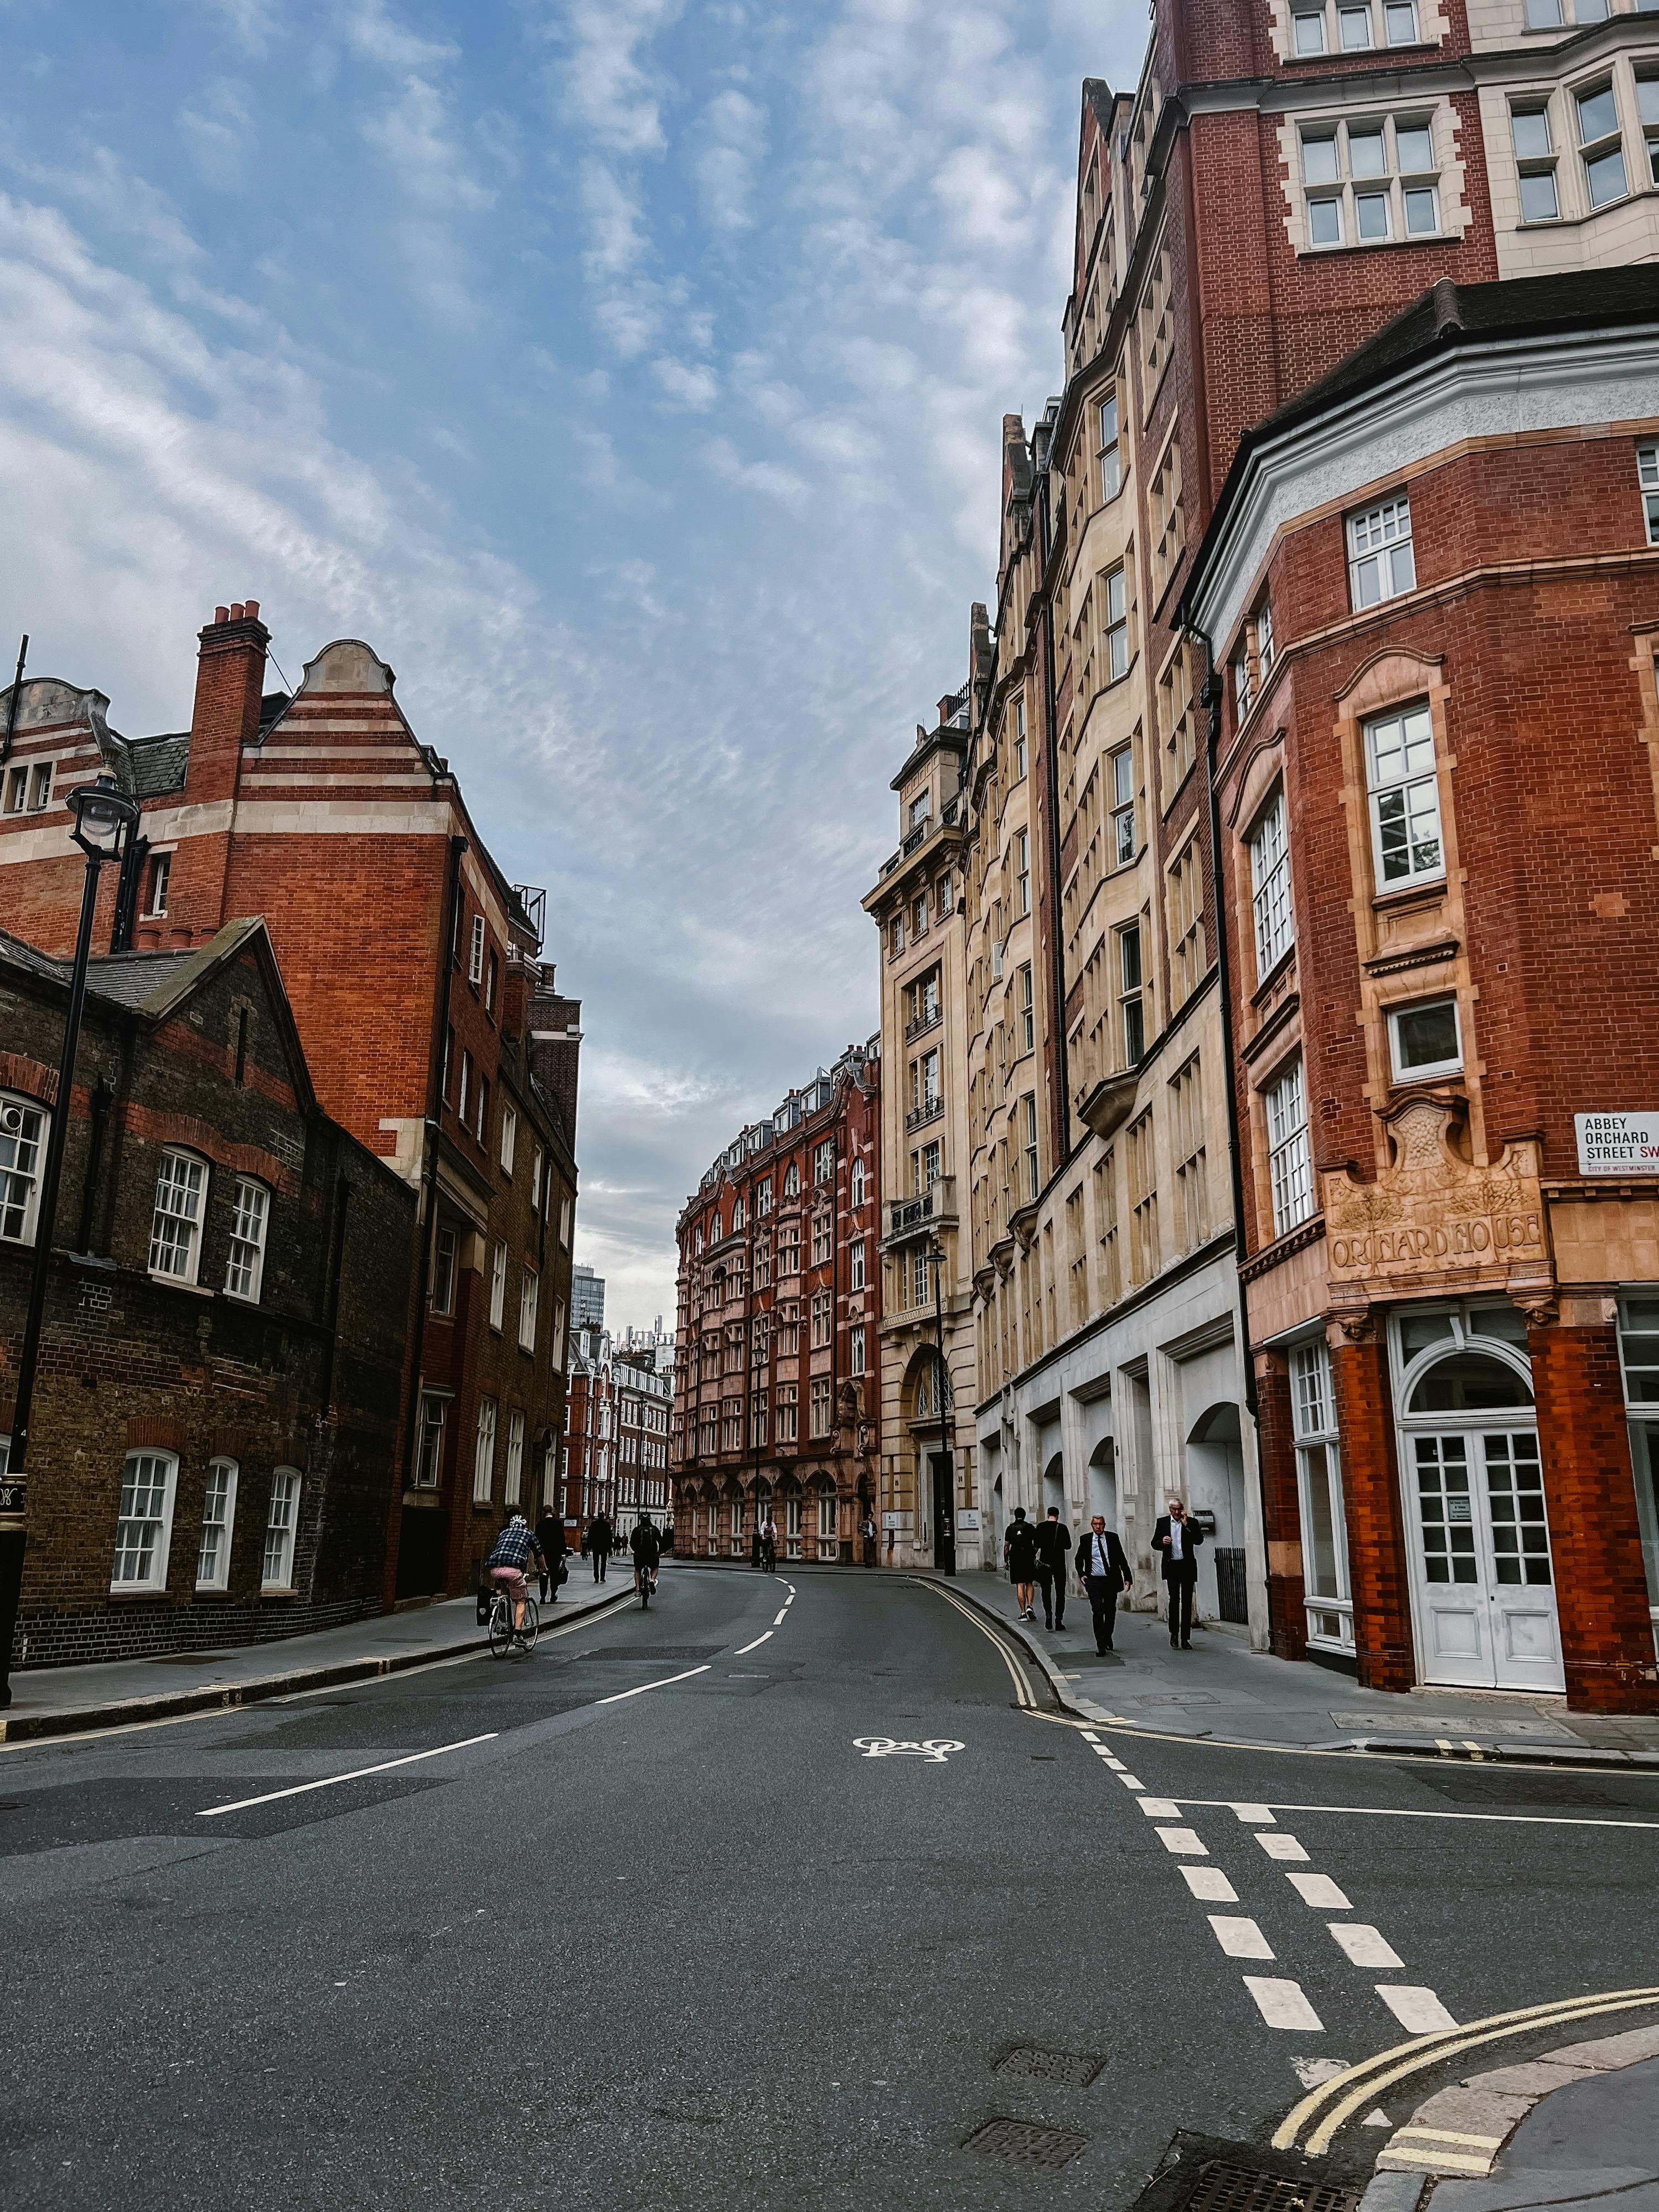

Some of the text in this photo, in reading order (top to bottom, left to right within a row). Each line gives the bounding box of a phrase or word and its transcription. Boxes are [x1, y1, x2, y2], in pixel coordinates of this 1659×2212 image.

[1585, 1118, 1626, 1130] ABBEY
[1586, 1132, 1648, 1144] ORCHARD
[1587, 1146, 1659, 1159] STREET SW
[1333, 1214, 1541, 1268] ORCHARD HOUSE
